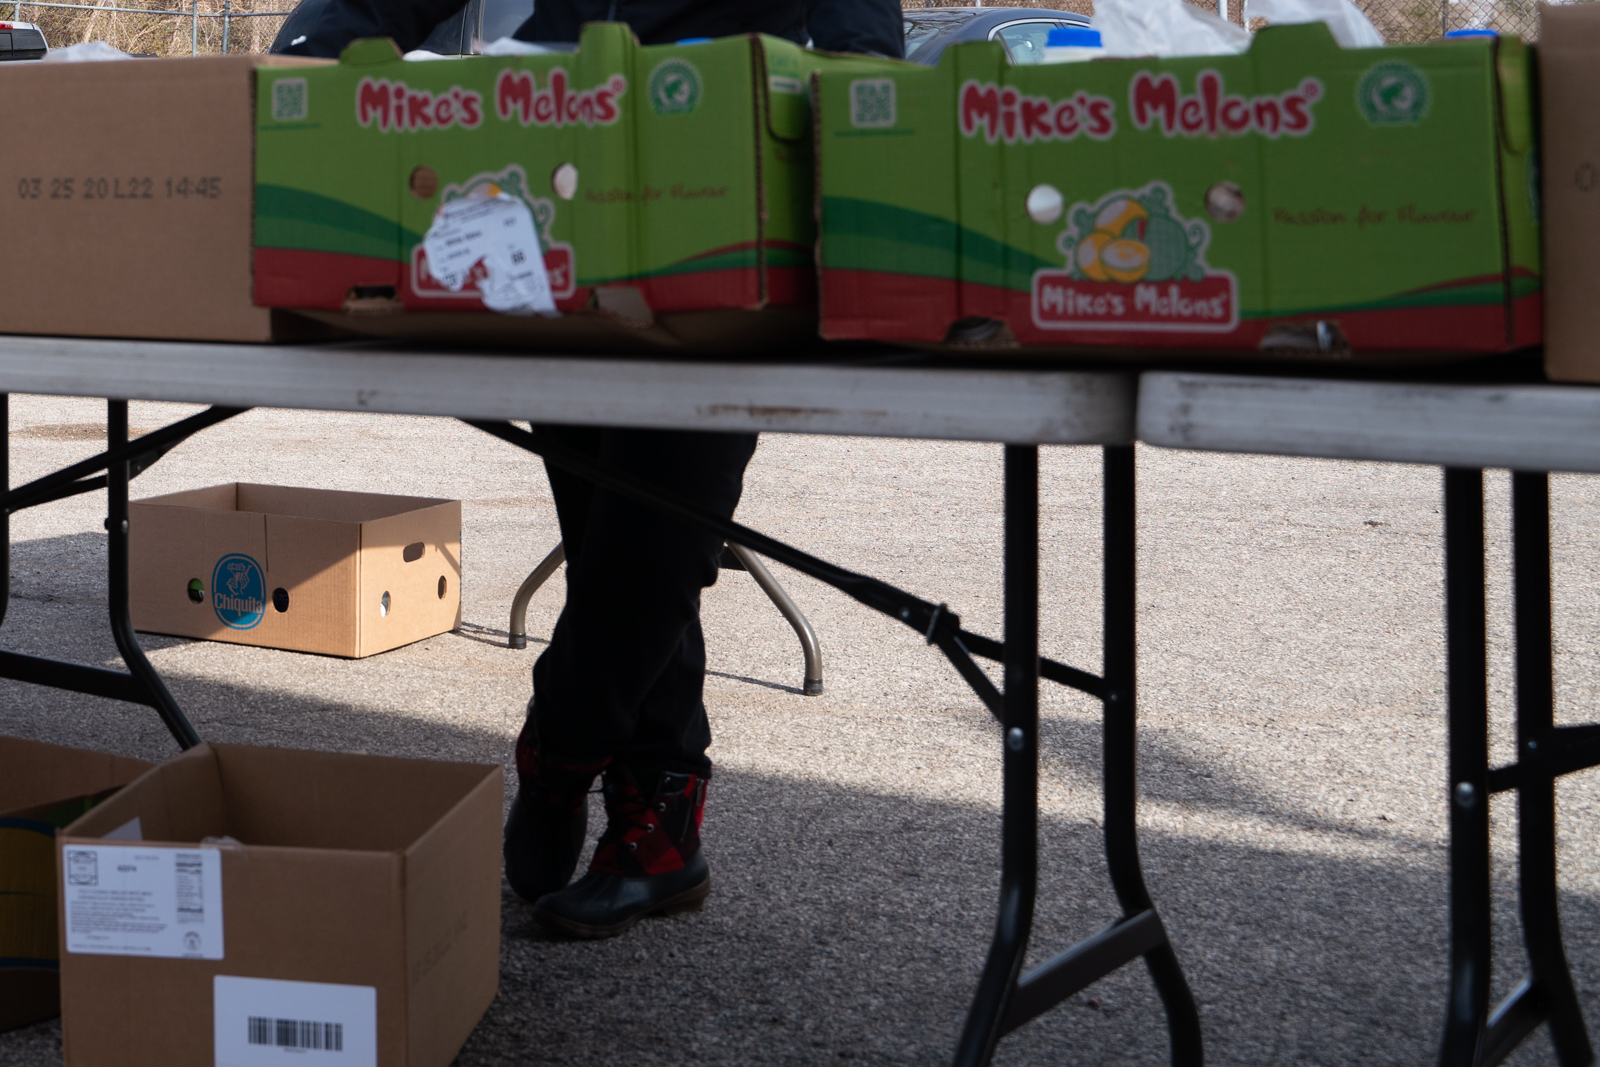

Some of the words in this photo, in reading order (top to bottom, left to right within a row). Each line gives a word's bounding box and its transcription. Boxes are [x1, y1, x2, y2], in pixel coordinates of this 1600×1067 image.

[357, 79, 482, 130] Mike's
[961, 80, 1114, 141] Mike's
[17, 177, 43, 200] 03
[51, 177, 76, 200] 25
[164, 176, 223, 200] 14:45
[1041, 284, 1126, 316] Mike's
[213, 592, 263, 617] Chiquita
